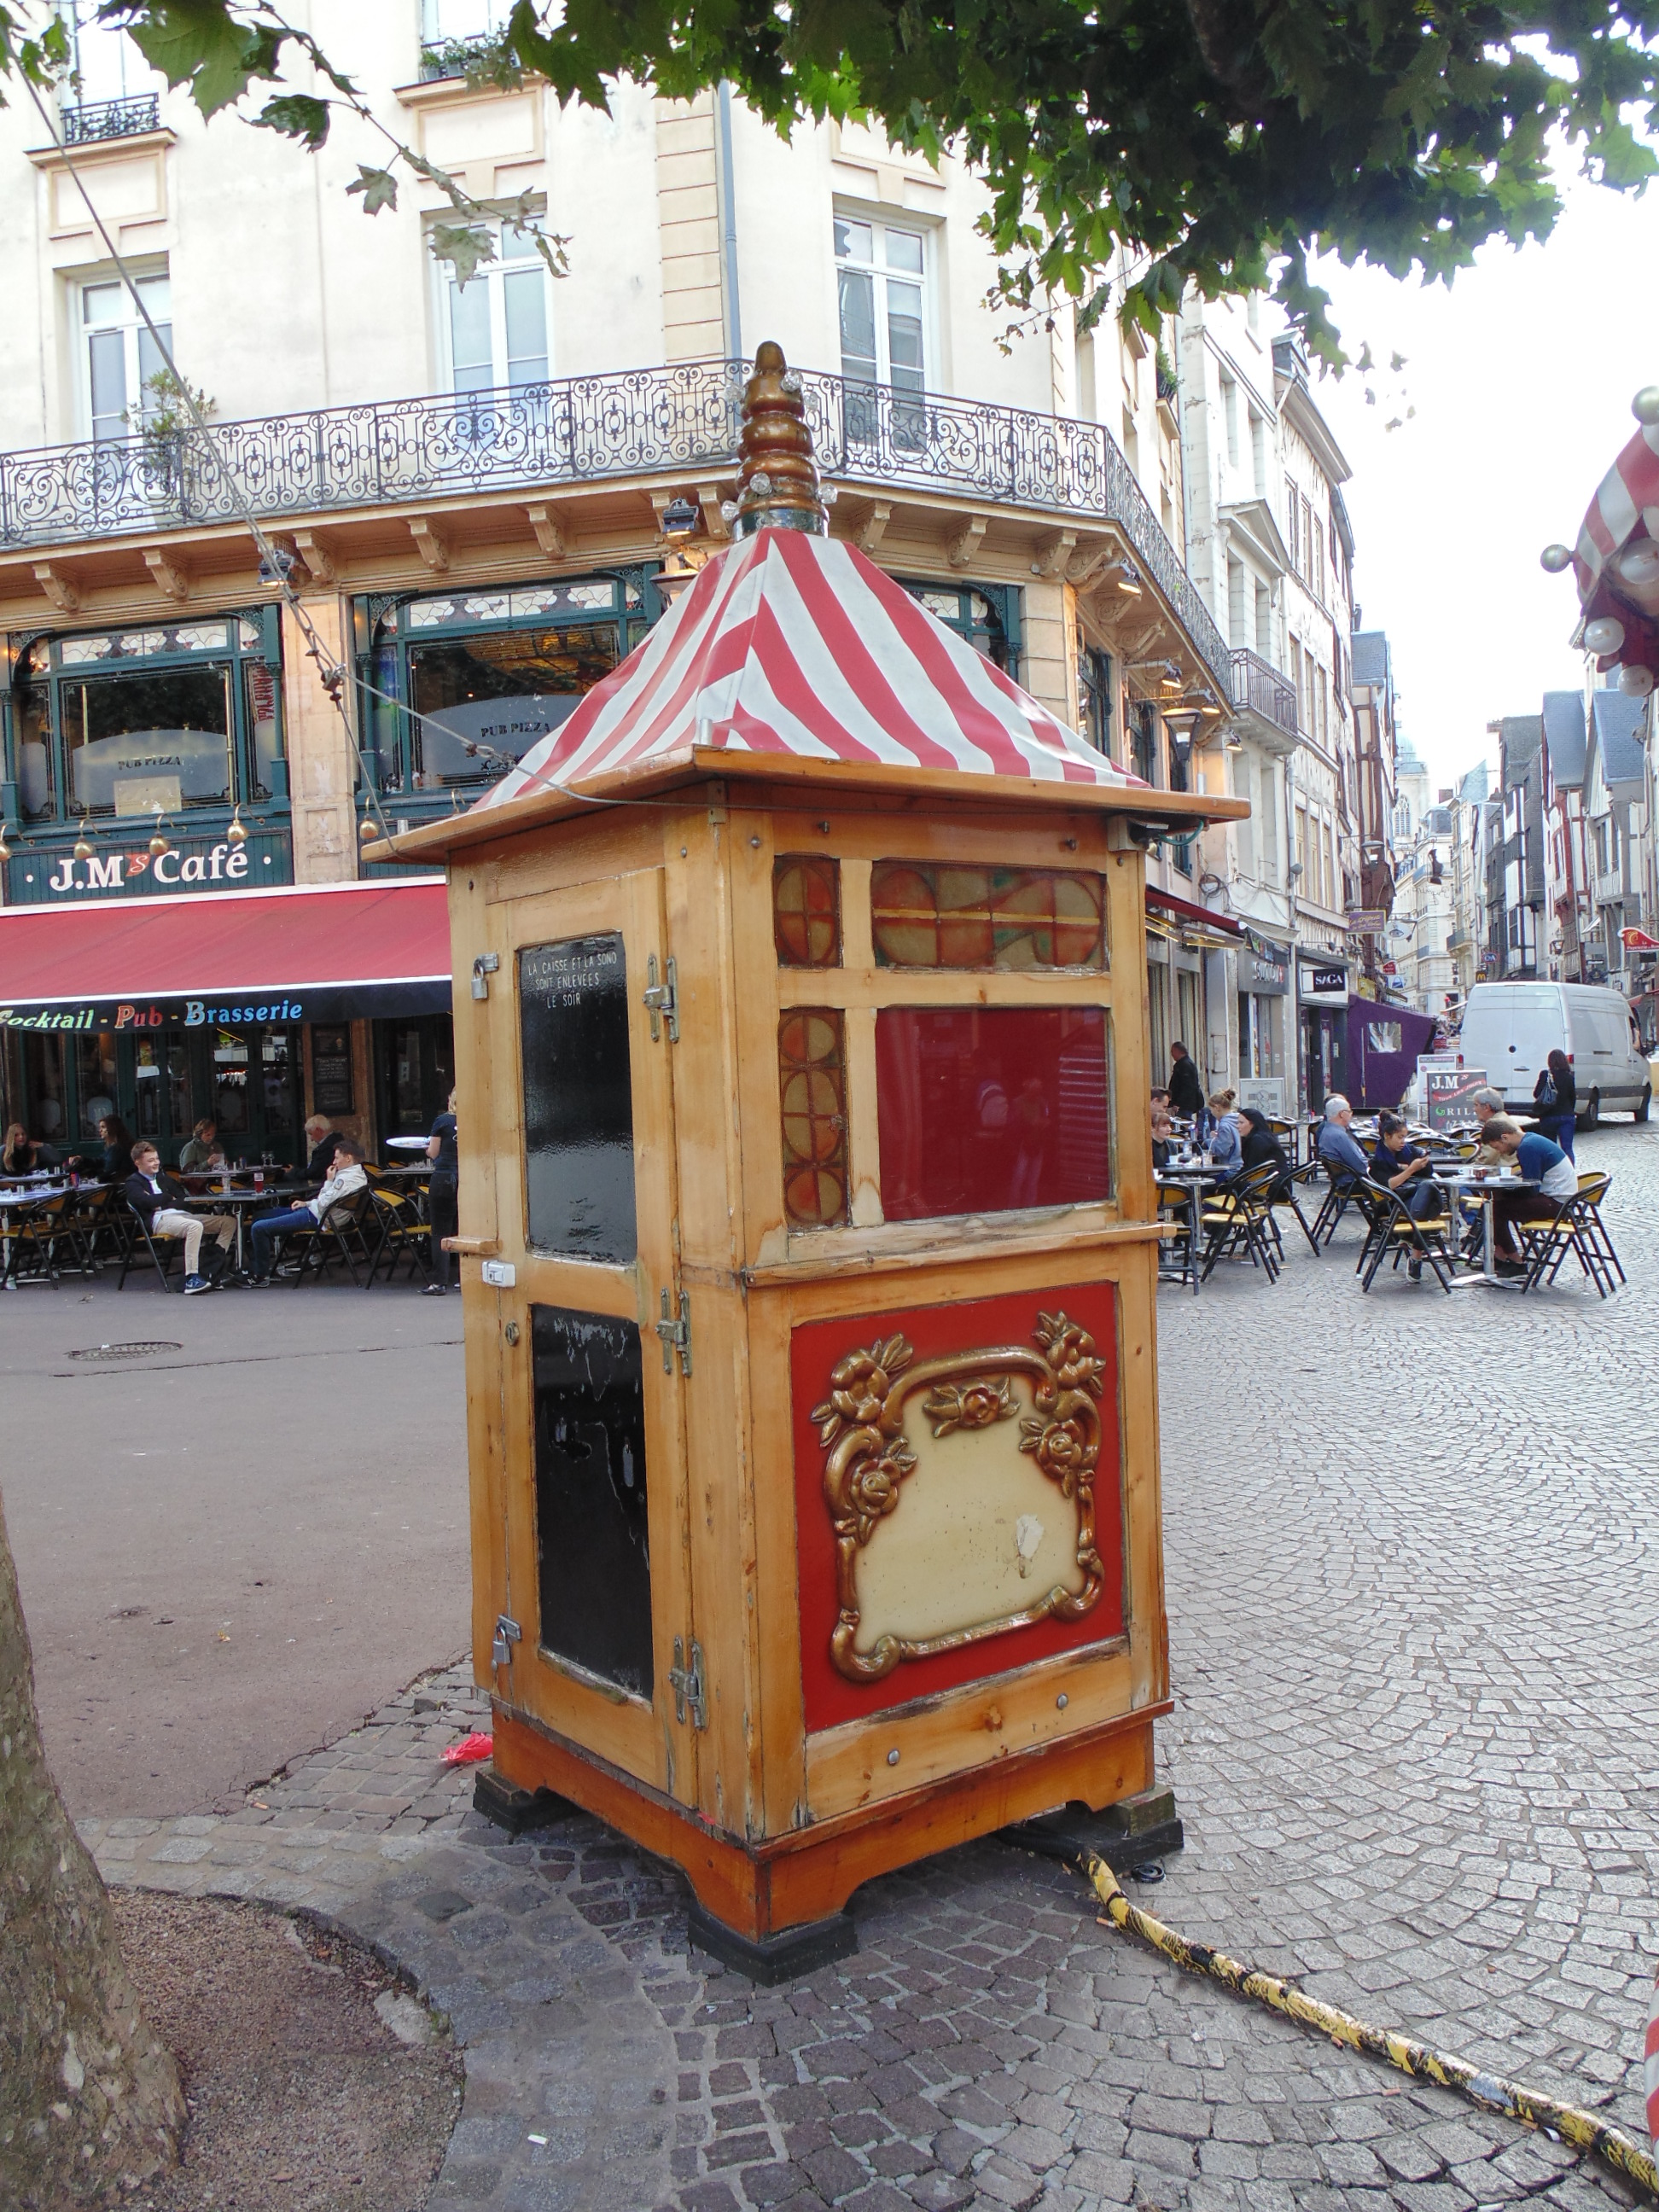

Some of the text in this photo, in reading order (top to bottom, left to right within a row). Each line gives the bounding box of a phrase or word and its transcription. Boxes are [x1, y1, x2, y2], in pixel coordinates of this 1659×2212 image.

[480, 722, 551, 737] PUB PIZZA
[118, 755, 182, 770] PUB PIZZA
[154, 842, 248, 883] Café
[528, 963, 538, 975] LA
[572, 957, 581, 969] ET
[585, 956, 594, 967] LA
[597, 952, 616, 965] SONO
[535, 977, 553, 990] SONT
[1315, 975, 1342, 985] SAGA
[547, 995, 556, 1008] LE
[0, 1010, 95, 1029] Cocktail
[114, 1005, 163, 1029] Pub
[183, 999, 303, 1027] Brasserie
